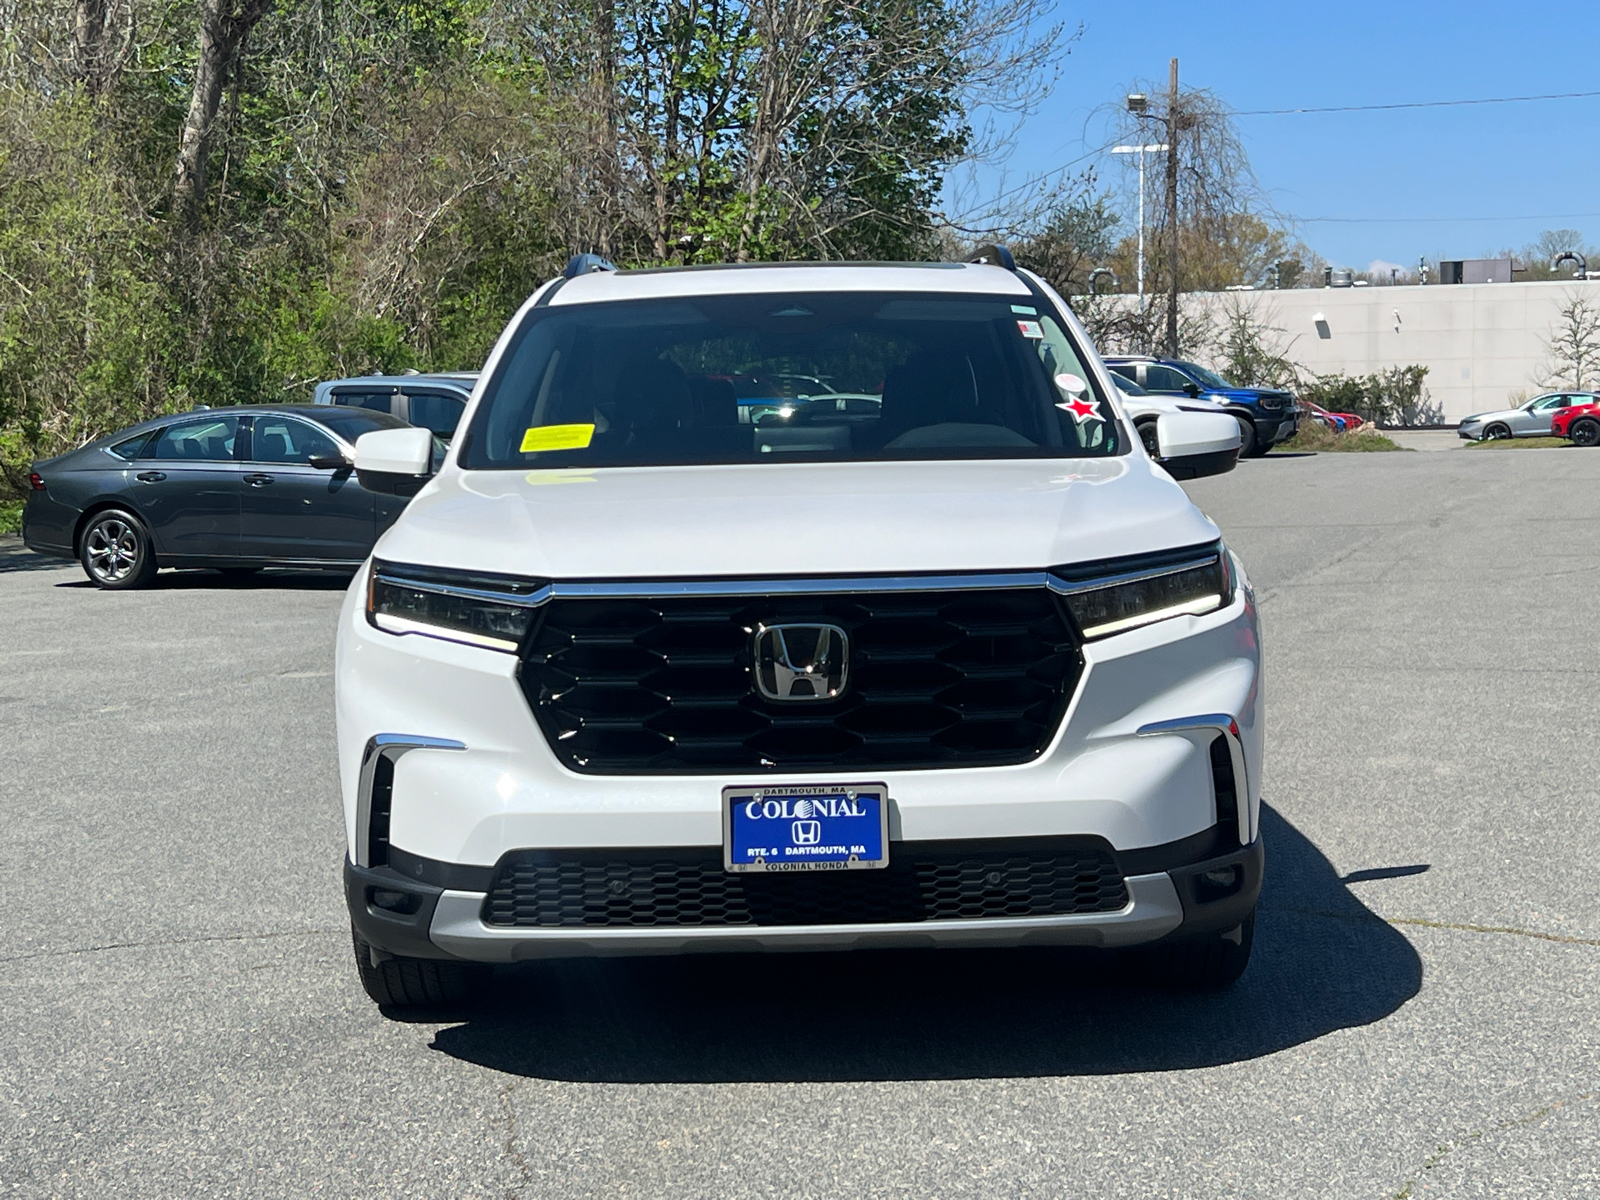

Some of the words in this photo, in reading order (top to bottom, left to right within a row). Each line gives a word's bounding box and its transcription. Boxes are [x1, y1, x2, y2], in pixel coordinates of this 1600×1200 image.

[745, 798, 866, 819] COLONIAL
[747, 848, 769, 857] RTE.
[771, 847, 778, 856] 6
[785, 845, 849, 855] DARTMOUTH,
[851, 845, 866, 853] MA
[765, 862, 811, 871] COLONIAL
[815, 861, 849, 870] HONDA
